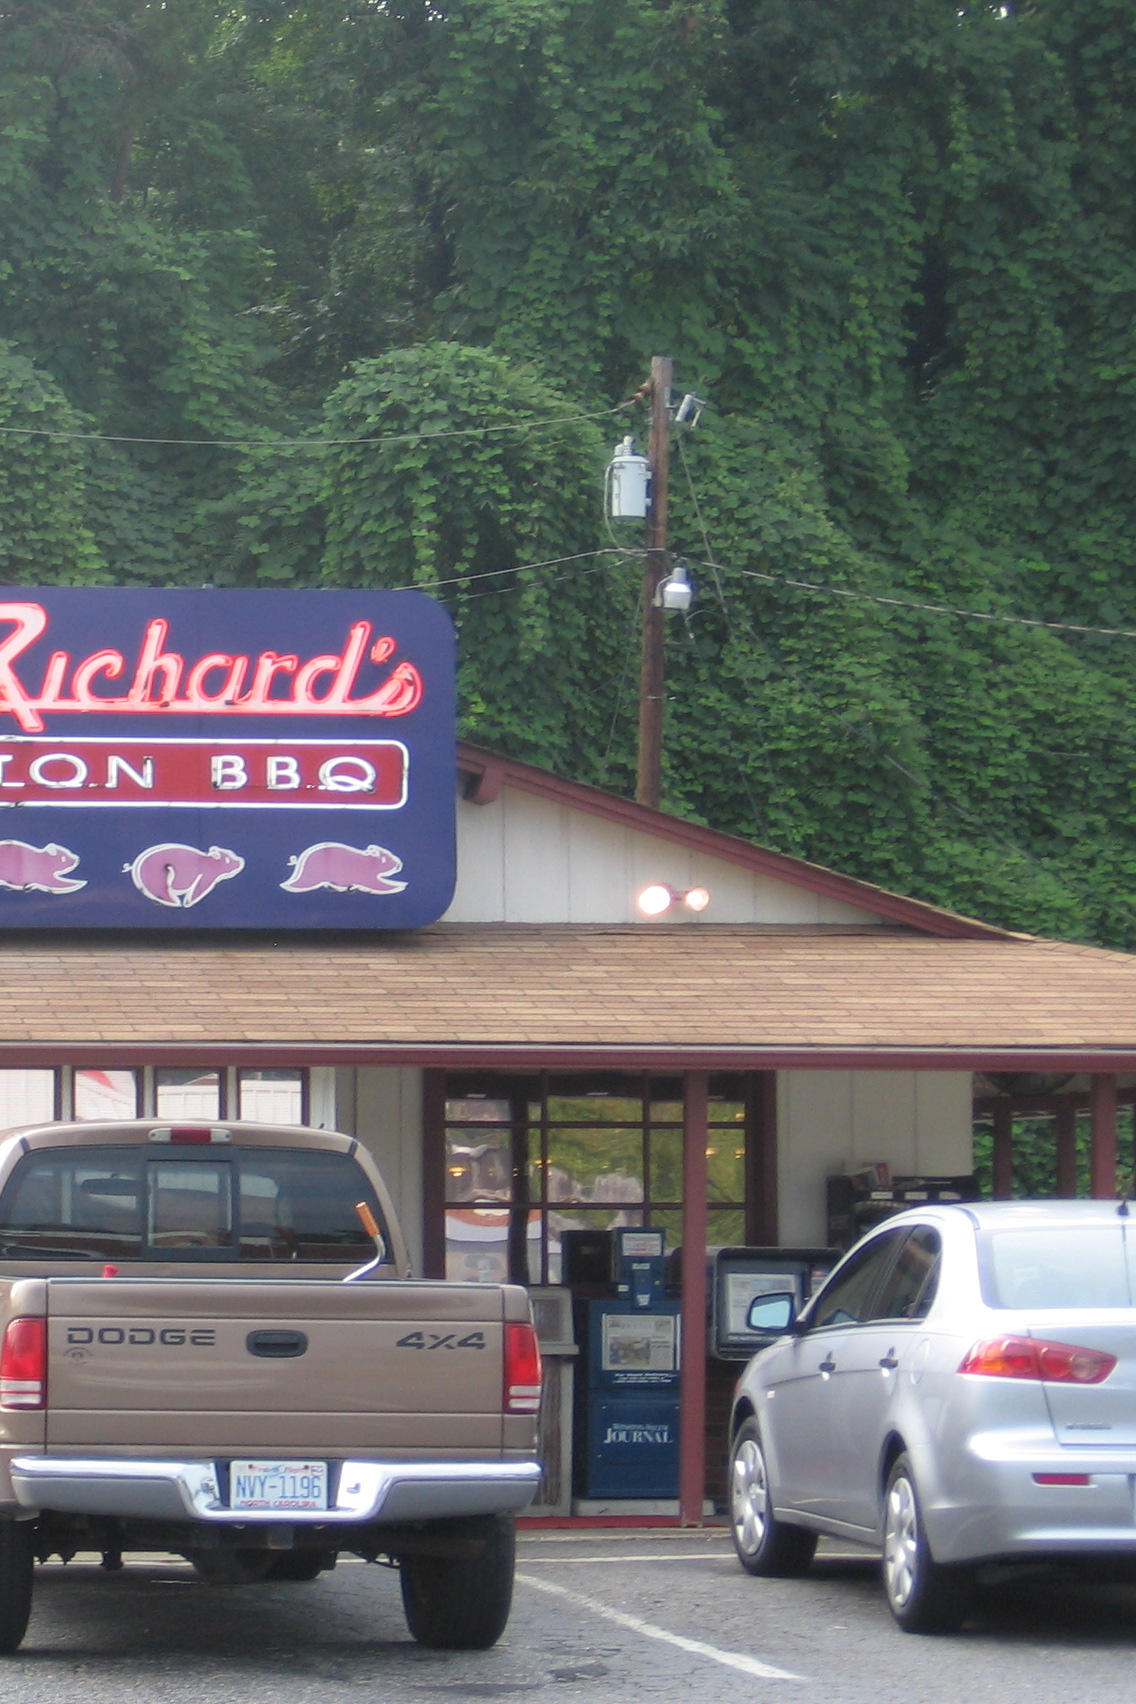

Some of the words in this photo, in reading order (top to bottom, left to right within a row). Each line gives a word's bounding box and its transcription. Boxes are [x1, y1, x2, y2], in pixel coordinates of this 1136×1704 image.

[210, 755, 376, 793] BBQ
[67, 1327, 216, 1345] DODGE
[603, 1427, 673, 1443] JOURNAL
[236, 1475, 322, 1499] NVY-1196
